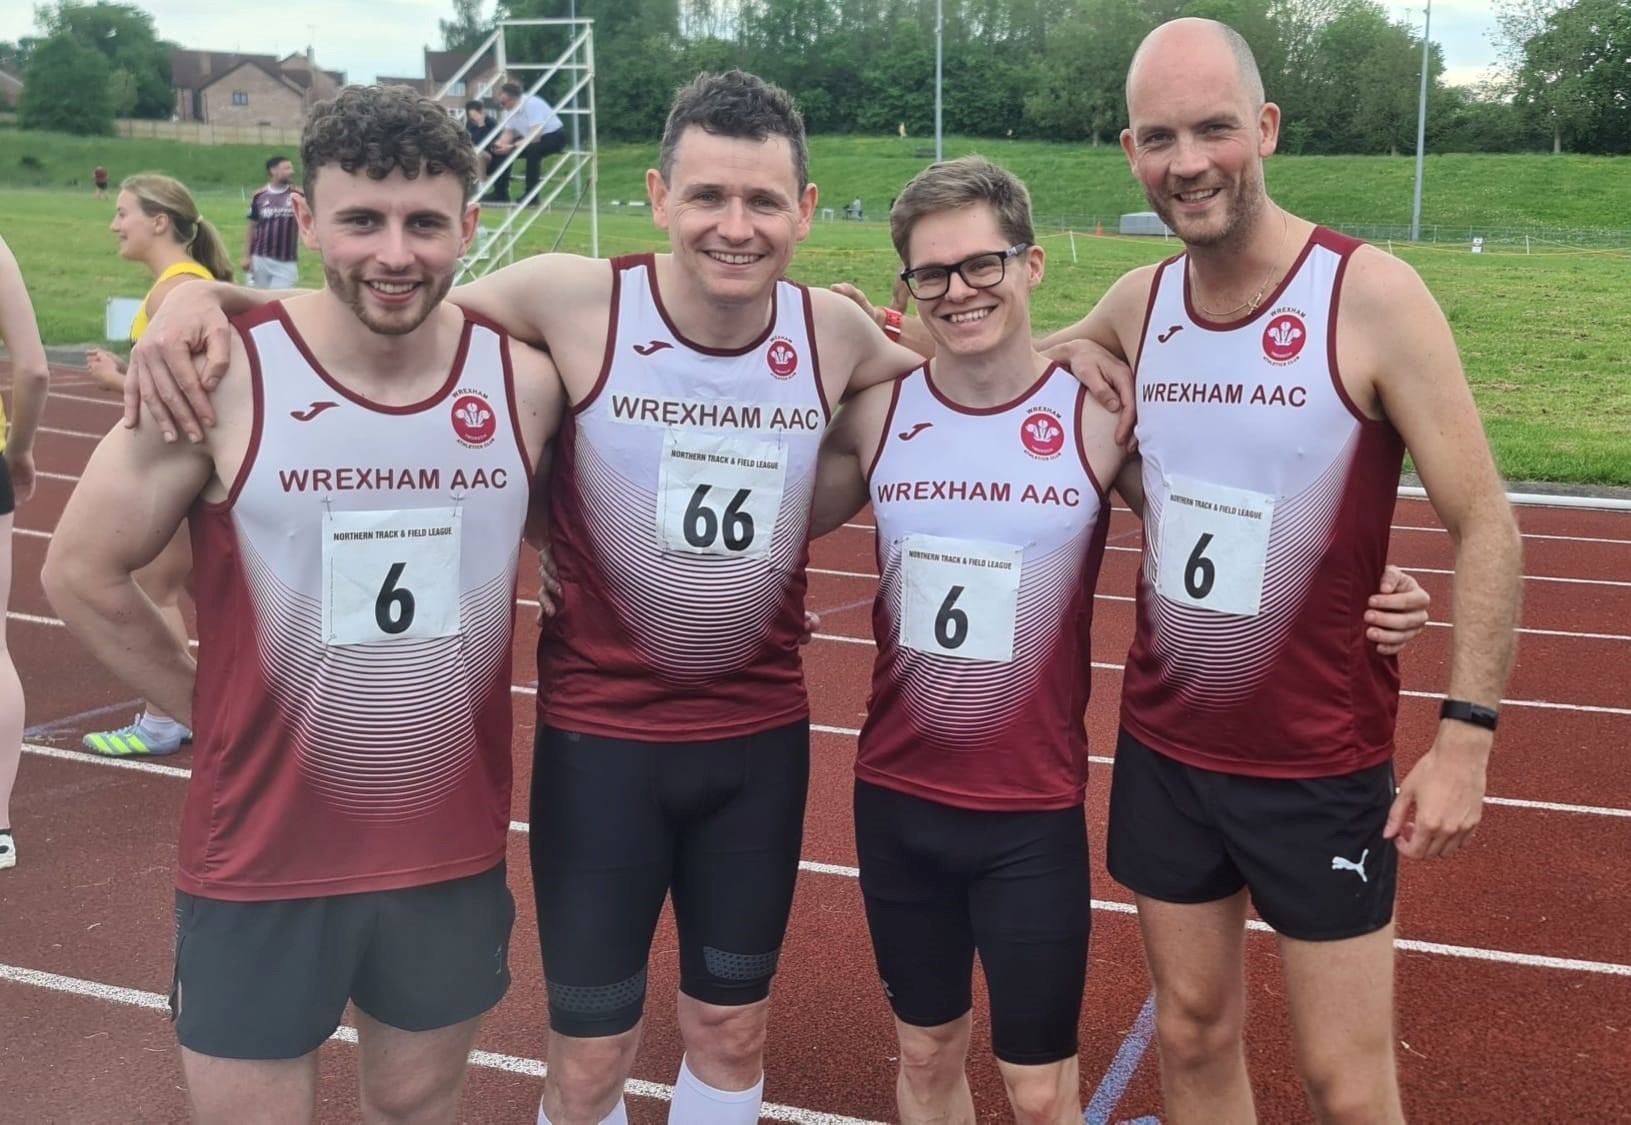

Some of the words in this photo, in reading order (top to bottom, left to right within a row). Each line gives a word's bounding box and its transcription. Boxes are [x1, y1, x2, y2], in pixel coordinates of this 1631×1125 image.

[452, 387, 489, 399] WREXHAM
[1142, 382, 1244, 404] WREXHAM
[1249, 384, 1307, 407] AAC
[611, 395, 761, 429] WREXHAM
[769, 407, 819, 431] AAC
[671, 449, 706, 461] NORTHERN
[708, 454, 729, 464] TRACK
[730, 457, 735, 465] &
[738, 458, 754, 468] FIELD
[756, 460, 779, 470] LEAGUE
[279, 468, 440, 492] WREXHAM
[450, 468, 508, 490] AAC
[877, 480, 1011, 504] WREXHAM
[1020, 484, 1080, 507] AAC
[682, 484, 755, 551] 66
[1170, 494, 1194, 506] NORTHERN
[1194, 499, 1212, 510] TRACK
[1213, 503, 1218, 511] &
[1219, 504, 1237, 515] FIELD
[1238, 508, 1263, 520] LEAGUE
[333, 531, 374, 541] NORTHERN
[375, 530, 398, 539] TRACK
[400, 529, 406, 538] &
[408, 528, 427, 537] FIELD
[428, 527, 452, 537] LEAGUE
[909, 550, 940, 561] NORTHERN
[941, 554, 960, 564] TRACK
[962, 557, 967, 565] &
[968, 558, 986, 567] FIELD
[987, 560, 1012, 570] LEAGUE
[1183, 532, 1215, 600] 6
[374, 562, 415, 634] 6
[934, 585, 969, 650] 6
